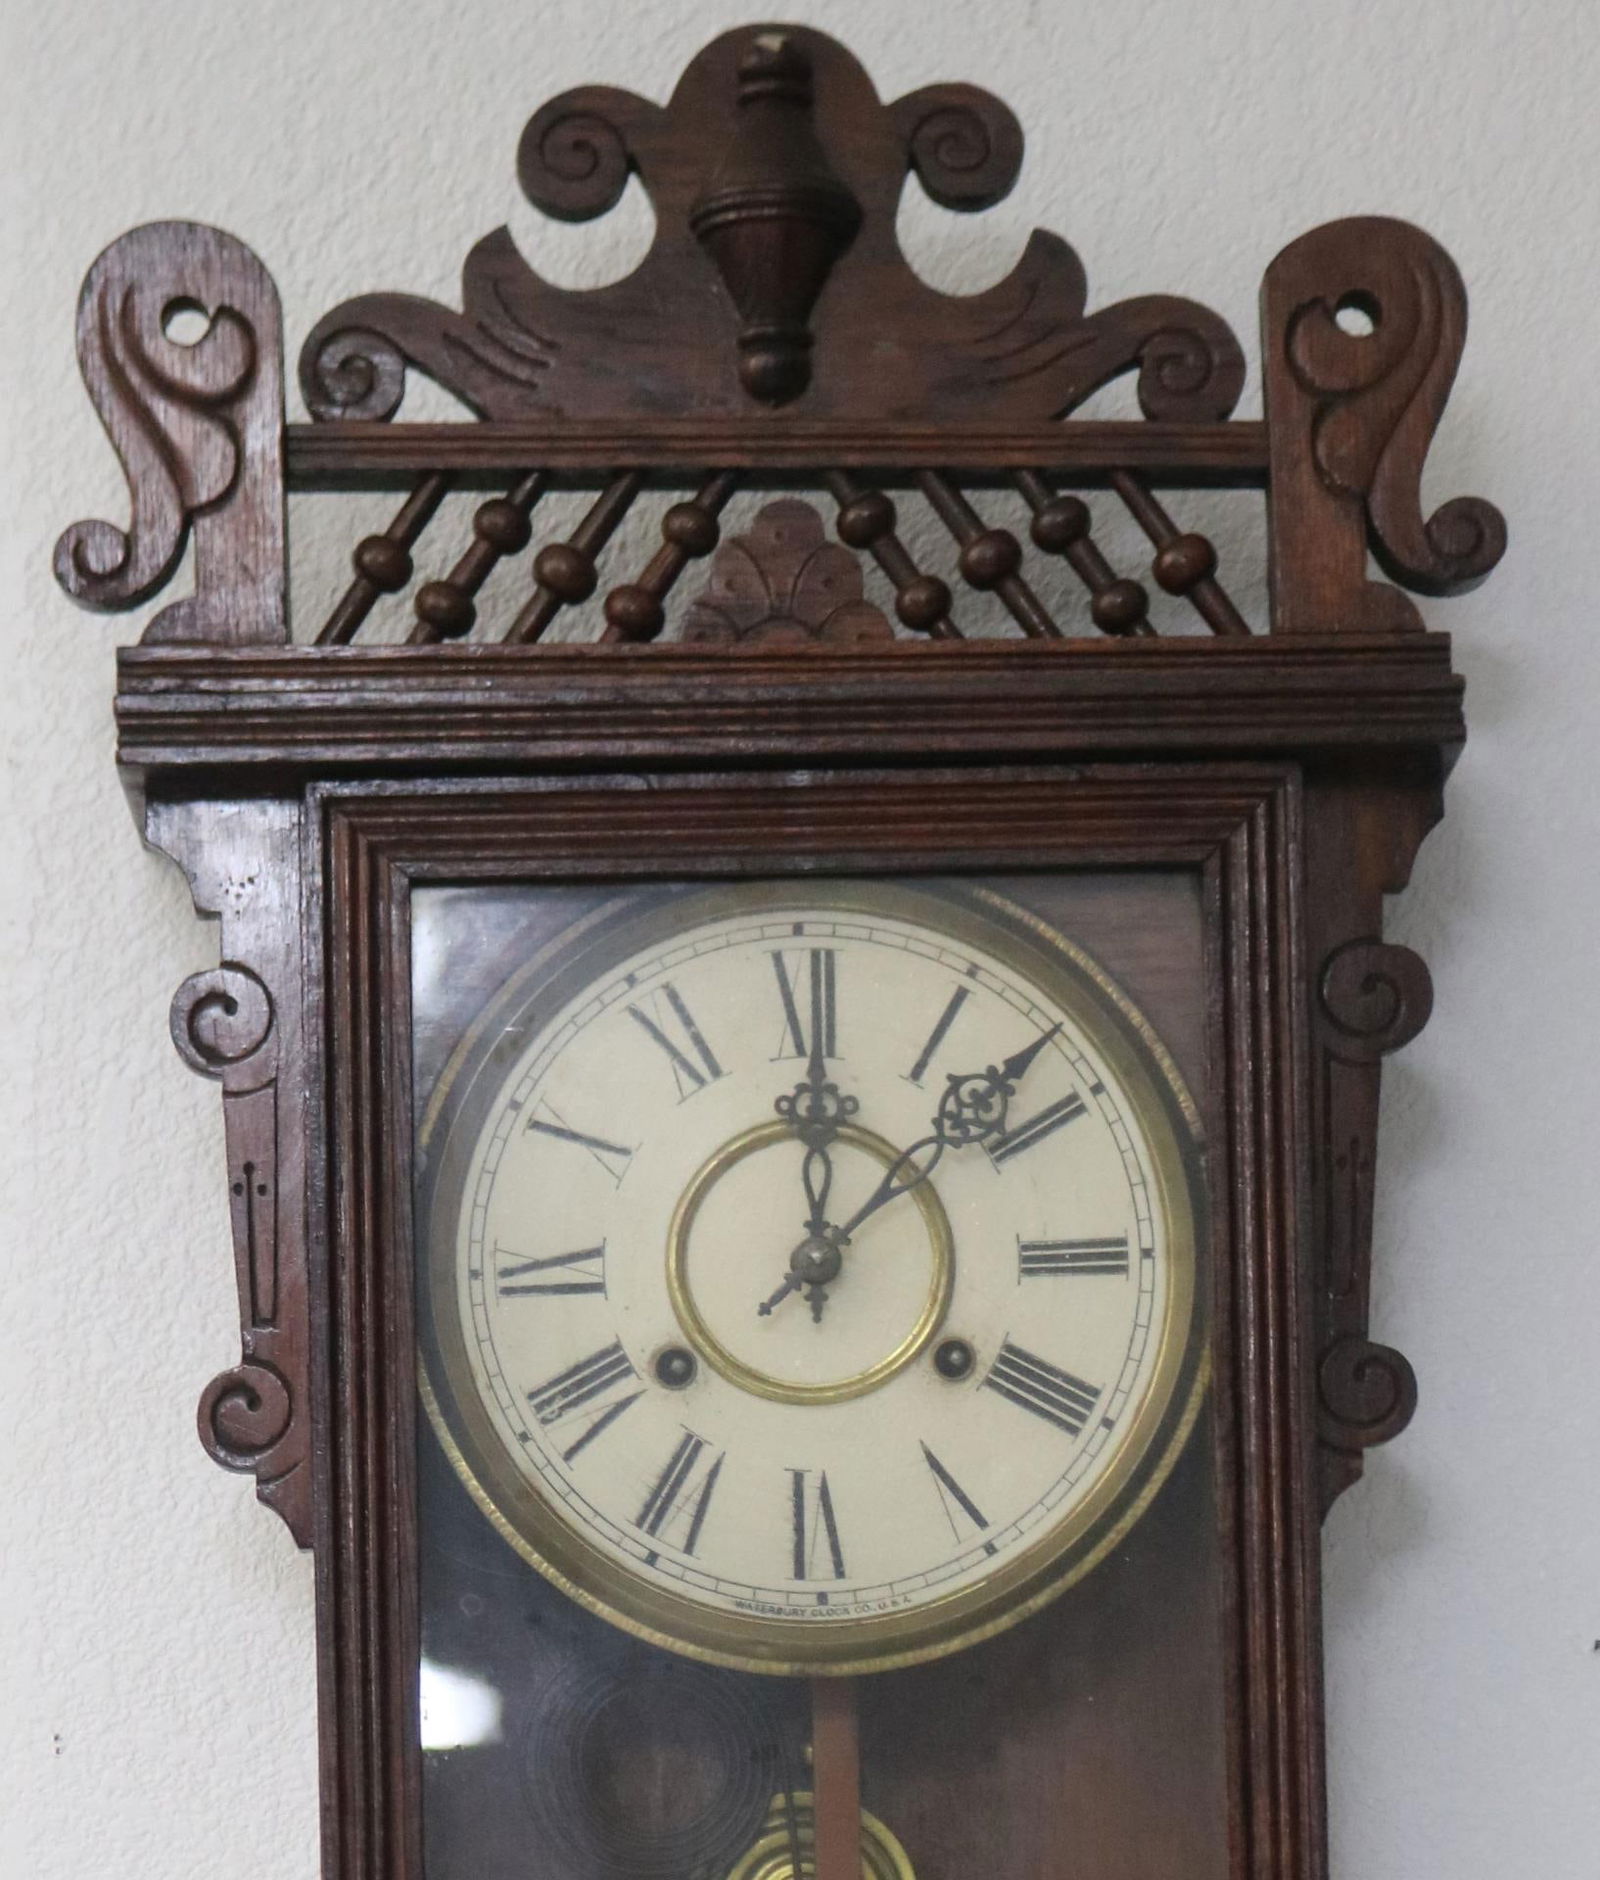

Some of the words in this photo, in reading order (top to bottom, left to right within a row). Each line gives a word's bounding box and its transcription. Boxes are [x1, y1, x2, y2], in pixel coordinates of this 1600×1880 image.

[621, 980, 734, 1104] XI
[767, 948, 843, 1061] XII
[523, 1093, 643, 1190] X
[980, 1085, 1092, 1175] II
[491, 1237, 608, 1303] IX
[1016, 1231, 1129, 1286] III
[520, 1334, 648, 1470] VIII
[977, 1332, 1105, 1441] IIII
[628, 1423, 727, 1558] VII
[784, 1468, 847, 1580] VI
[920, 1438, 991, 1544] V
[735, 1599, 807, 1617] WATERBURY
[811, 1607, 850, 1617] CLOCK
